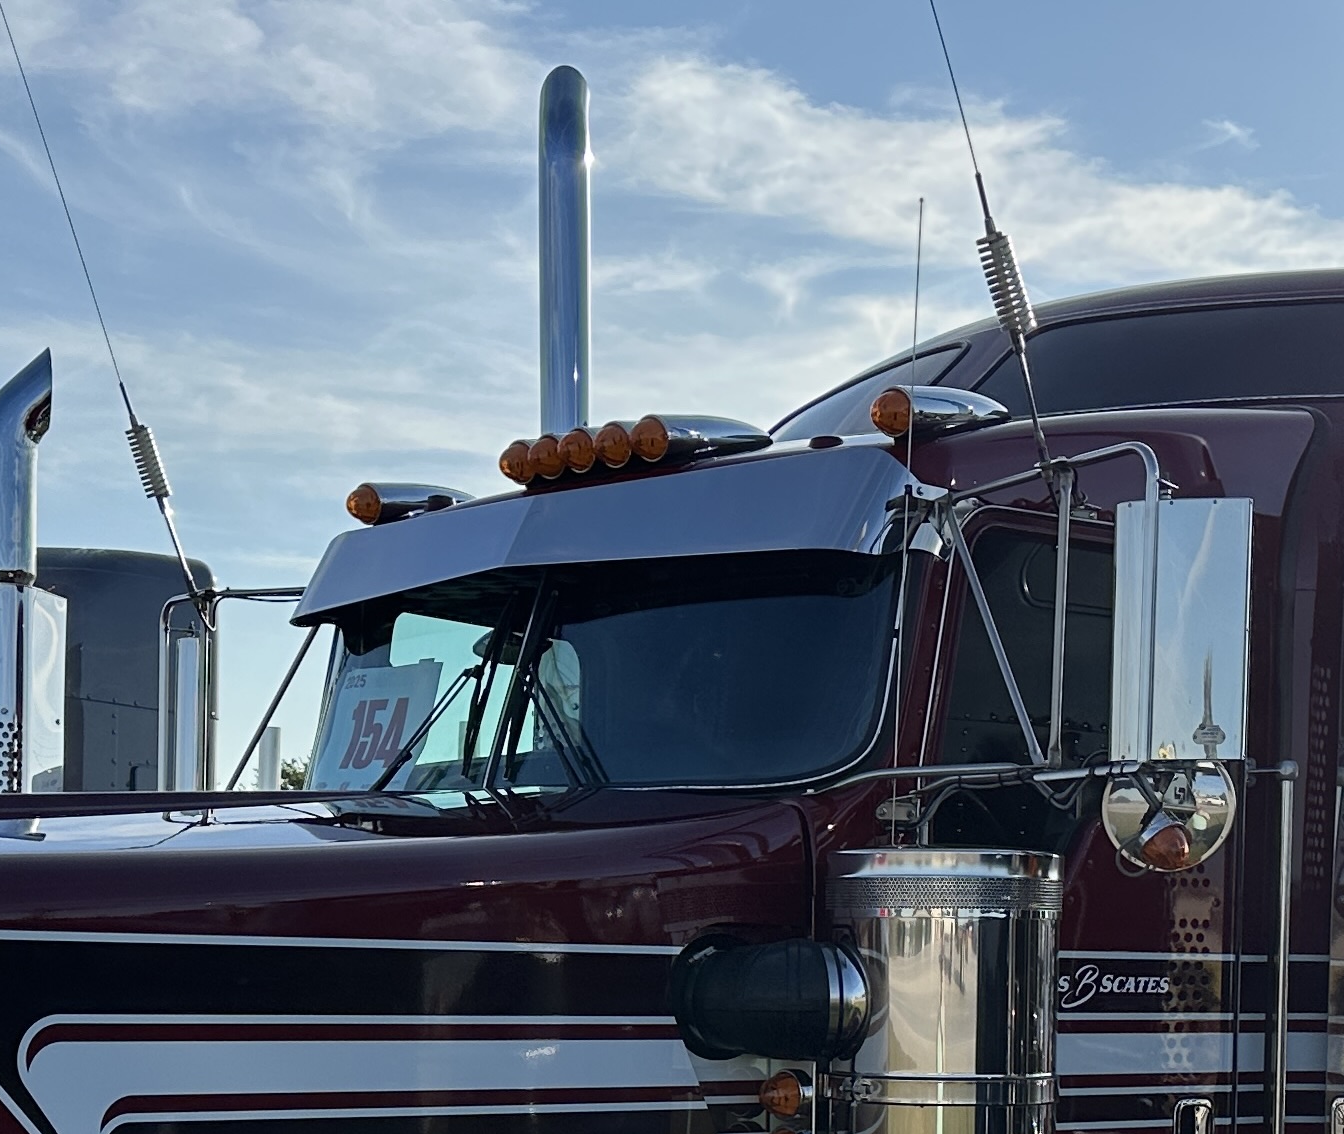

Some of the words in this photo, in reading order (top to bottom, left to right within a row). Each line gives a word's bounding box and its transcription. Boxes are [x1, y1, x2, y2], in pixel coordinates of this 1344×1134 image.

[345, 674, 367, 690] 2025
[339, 697, 410, 770] 154
[1099, 974, 1171, 993] SCATES
